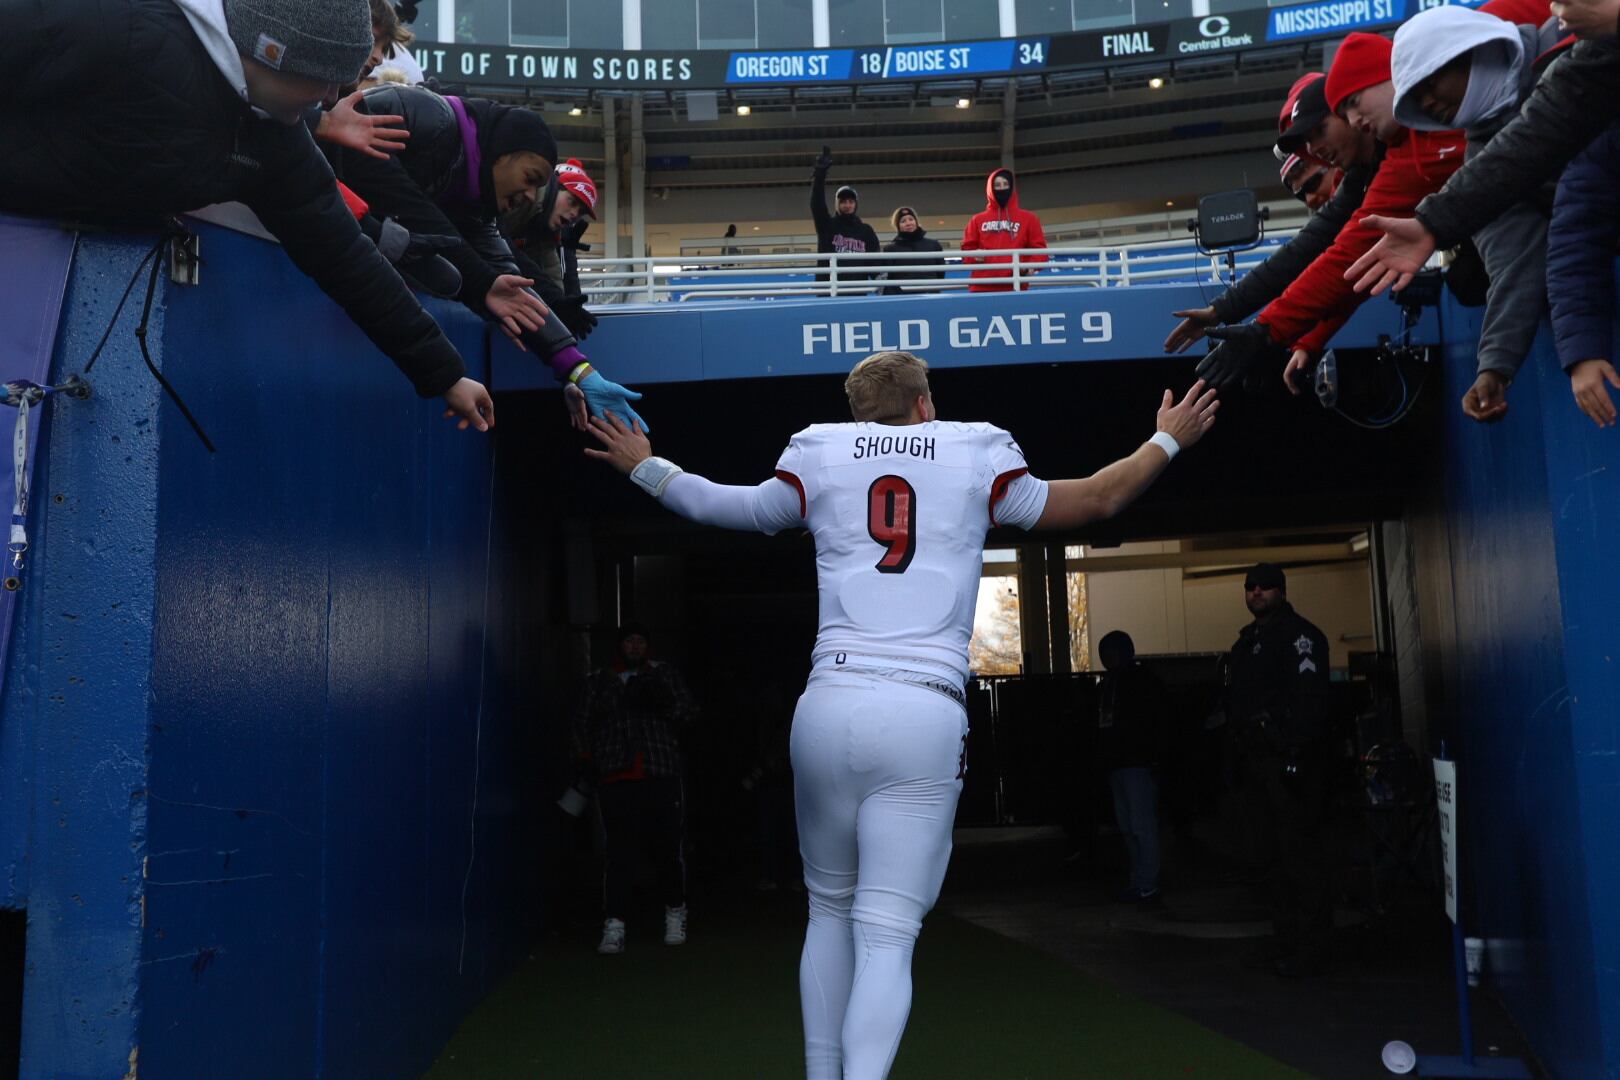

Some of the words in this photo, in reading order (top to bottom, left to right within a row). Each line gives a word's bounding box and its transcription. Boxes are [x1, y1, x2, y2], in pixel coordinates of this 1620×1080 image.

[1275, 5, 1369, 35] MISSISSIPPI
[1374, 0, 1393, 19] ST
[1102, 32, 1154, 57] FINAL
[1179, 38, 1220, 53] Central
[1222, 33, 1253, 47] Bank
[415, 48, 446, 73] UT
[461, 52, 491, 75] OF
[506, 54, 577, 79] TOWN
[592, 58, 692, 80] SCORES
[736, 56, 803, 78] OREGON
[808, 54, 829, 76] ST
[950, 48, 970, 69] ST
[1020, 42, 1044, 65] 34
[803, 319, 930, 355] FIELD
[949, 312, 1067, 348] GATE
[1081, 311, 1113, 343] 9
[853, 436, 936, 461] SHOUGH
[867, 474, 917, 574] 9
